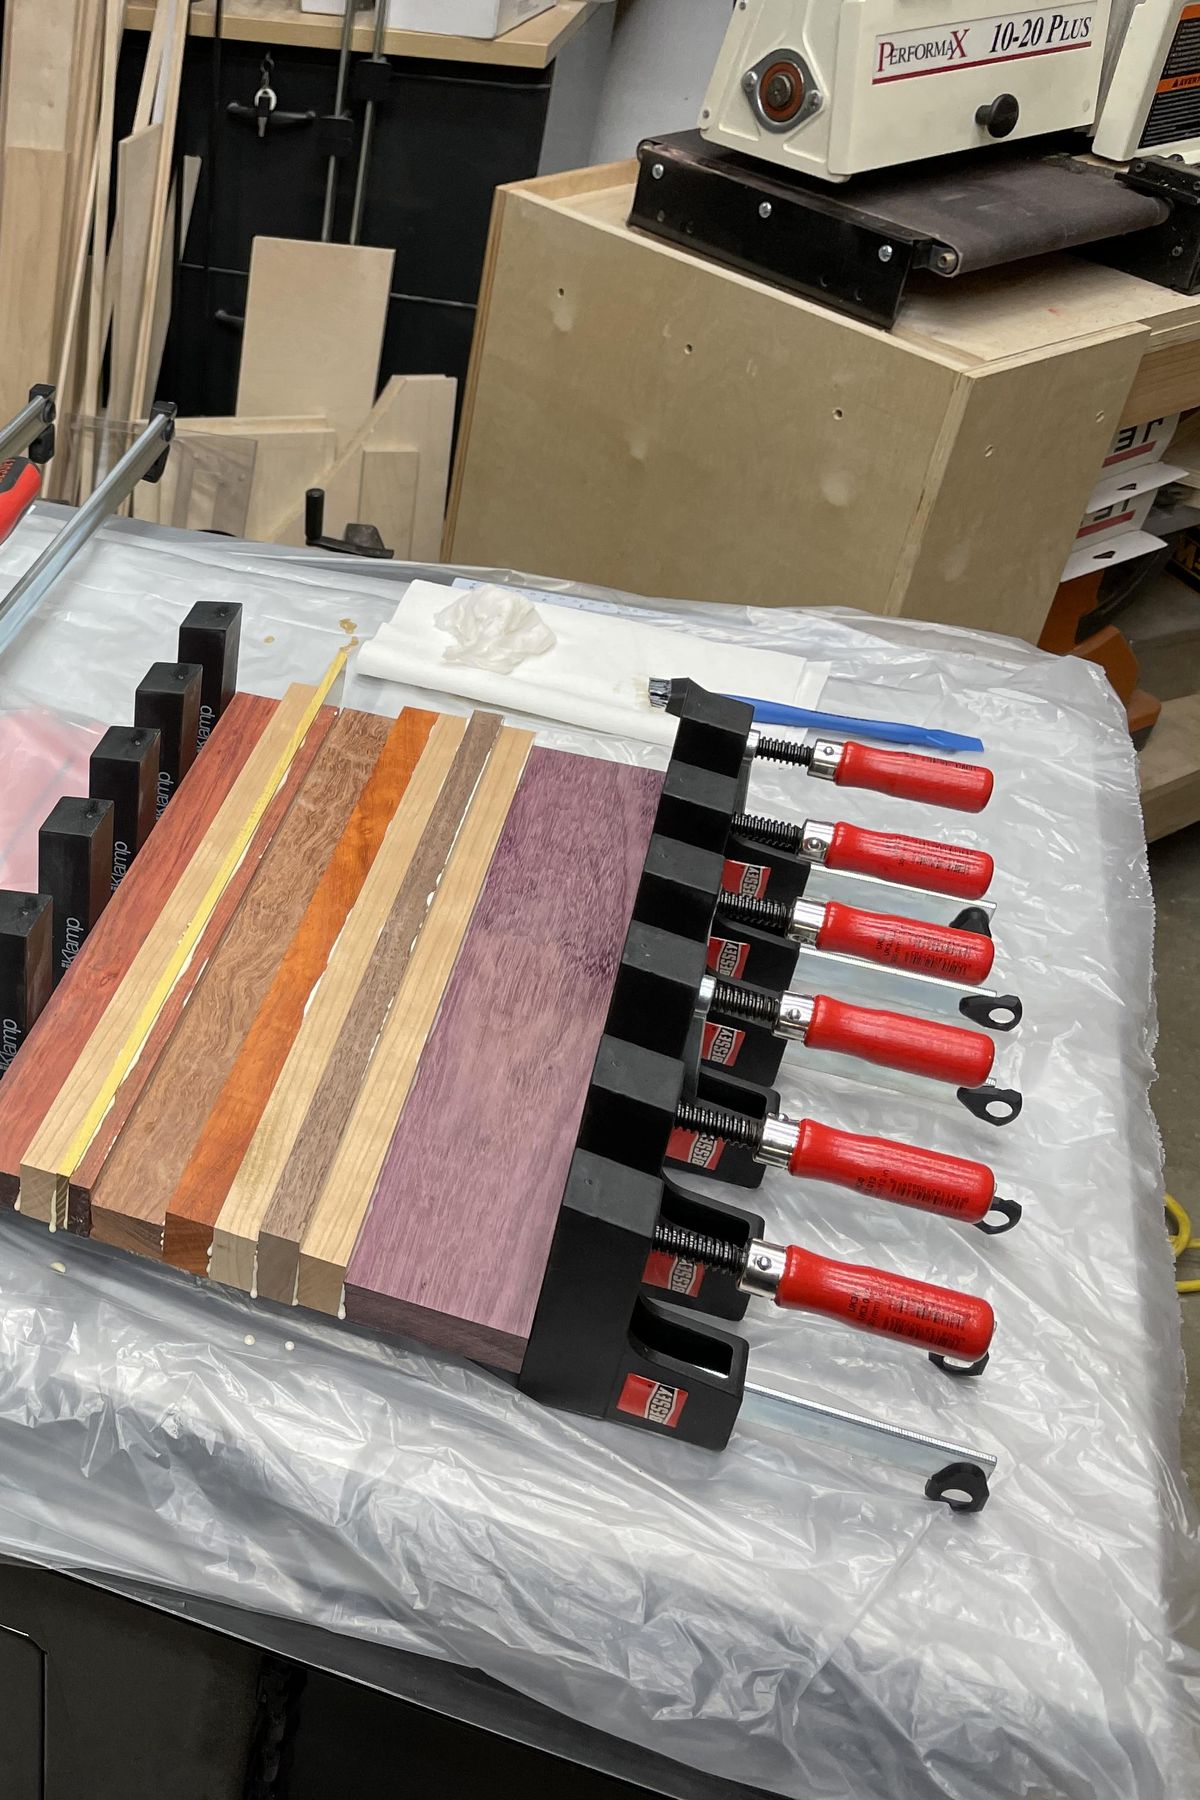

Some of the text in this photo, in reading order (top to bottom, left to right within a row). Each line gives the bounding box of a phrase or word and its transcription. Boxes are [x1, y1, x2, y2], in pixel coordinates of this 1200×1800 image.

[989, 16, 1044, 54] 10-20
[711, 1028, 734, 1064] BESSEY
[648, 1386, 674, 1425] BESSEY
